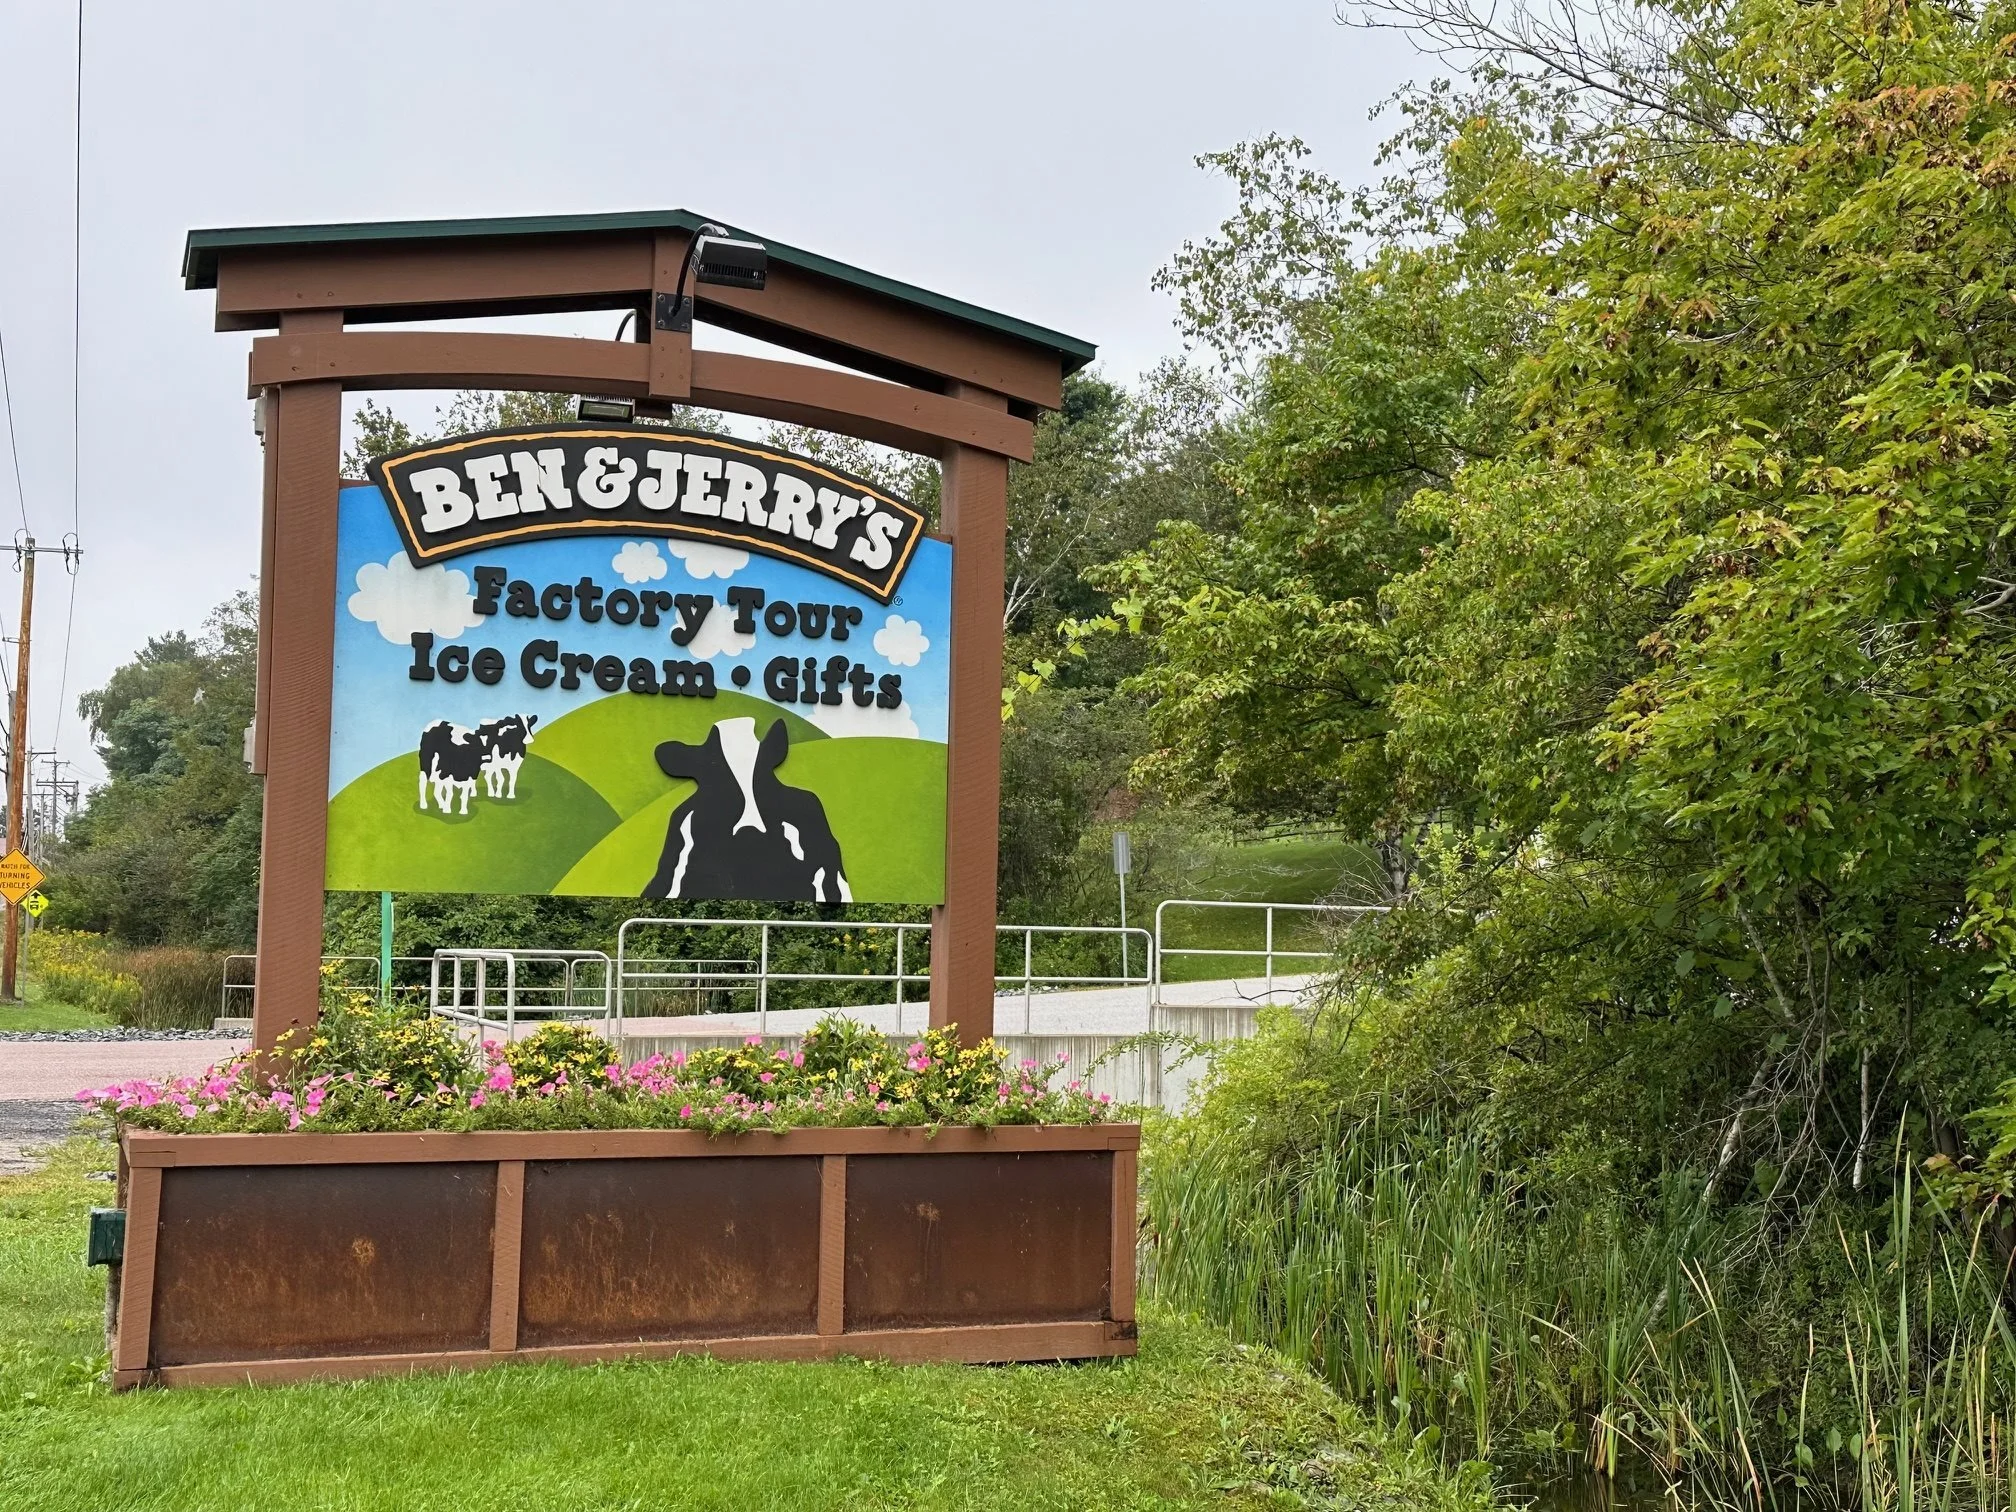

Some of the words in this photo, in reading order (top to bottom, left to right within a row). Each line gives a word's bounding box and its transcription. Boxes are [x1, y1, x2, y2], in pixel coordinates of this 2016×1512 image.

[408, 447, 573, 533] BEN
[576, 446, 638, 509] &
[637, 449, 904, 570] JERRY'S
[472, 565, 714, 647] Factory
[727, 585, 863, 641] Tour
[408, 632, 506, 686] Ice
[520, 638, 718, 699] Cream
[763, 655, 903, 709] Gifts
